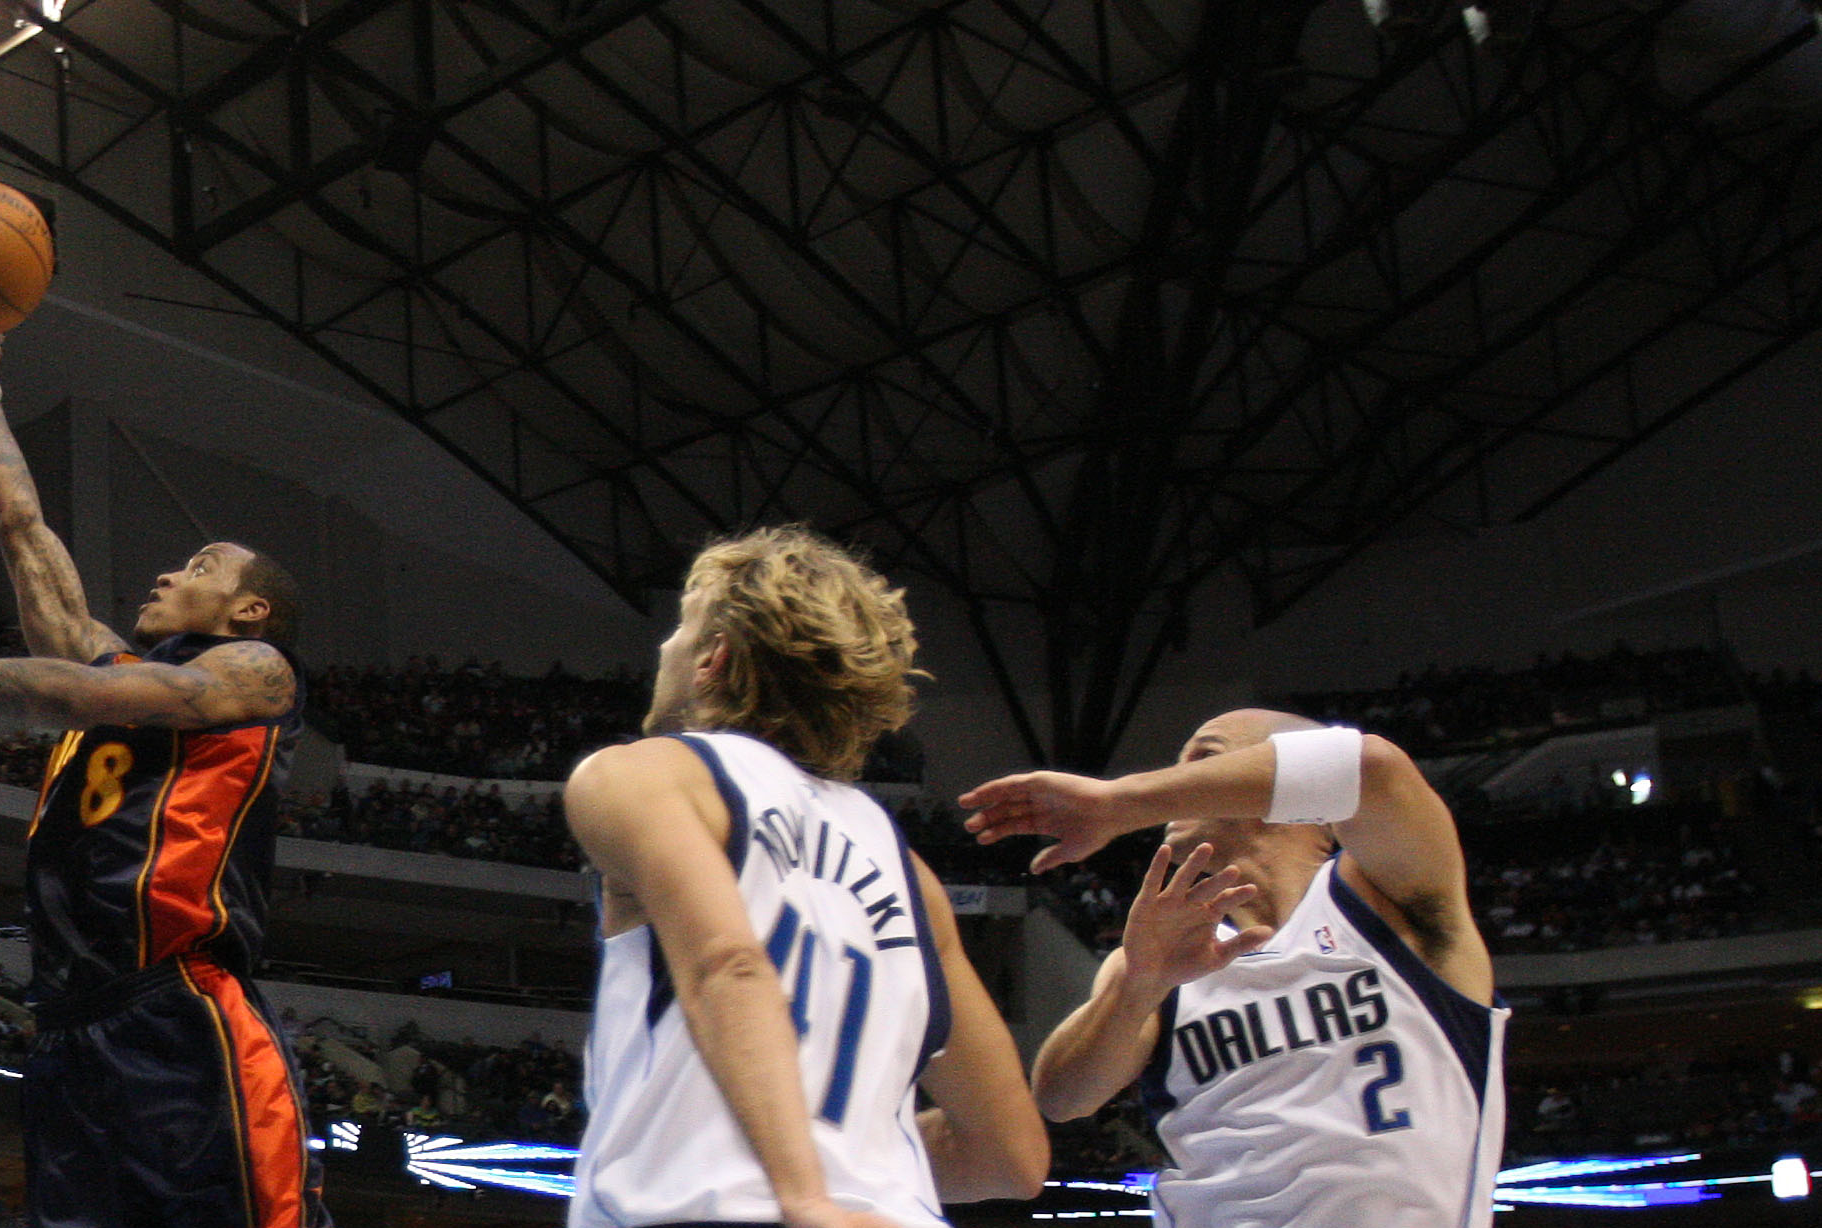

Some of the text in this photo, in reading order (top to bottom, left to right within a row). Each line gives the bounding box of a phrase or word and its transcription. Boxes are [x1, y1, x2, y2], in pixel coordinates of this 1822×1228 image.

[80, 741, 135, 829] 8
[1175, 968, 1389, 1086] DALLAS
[1354, 1040, 1414, 1137] 2
